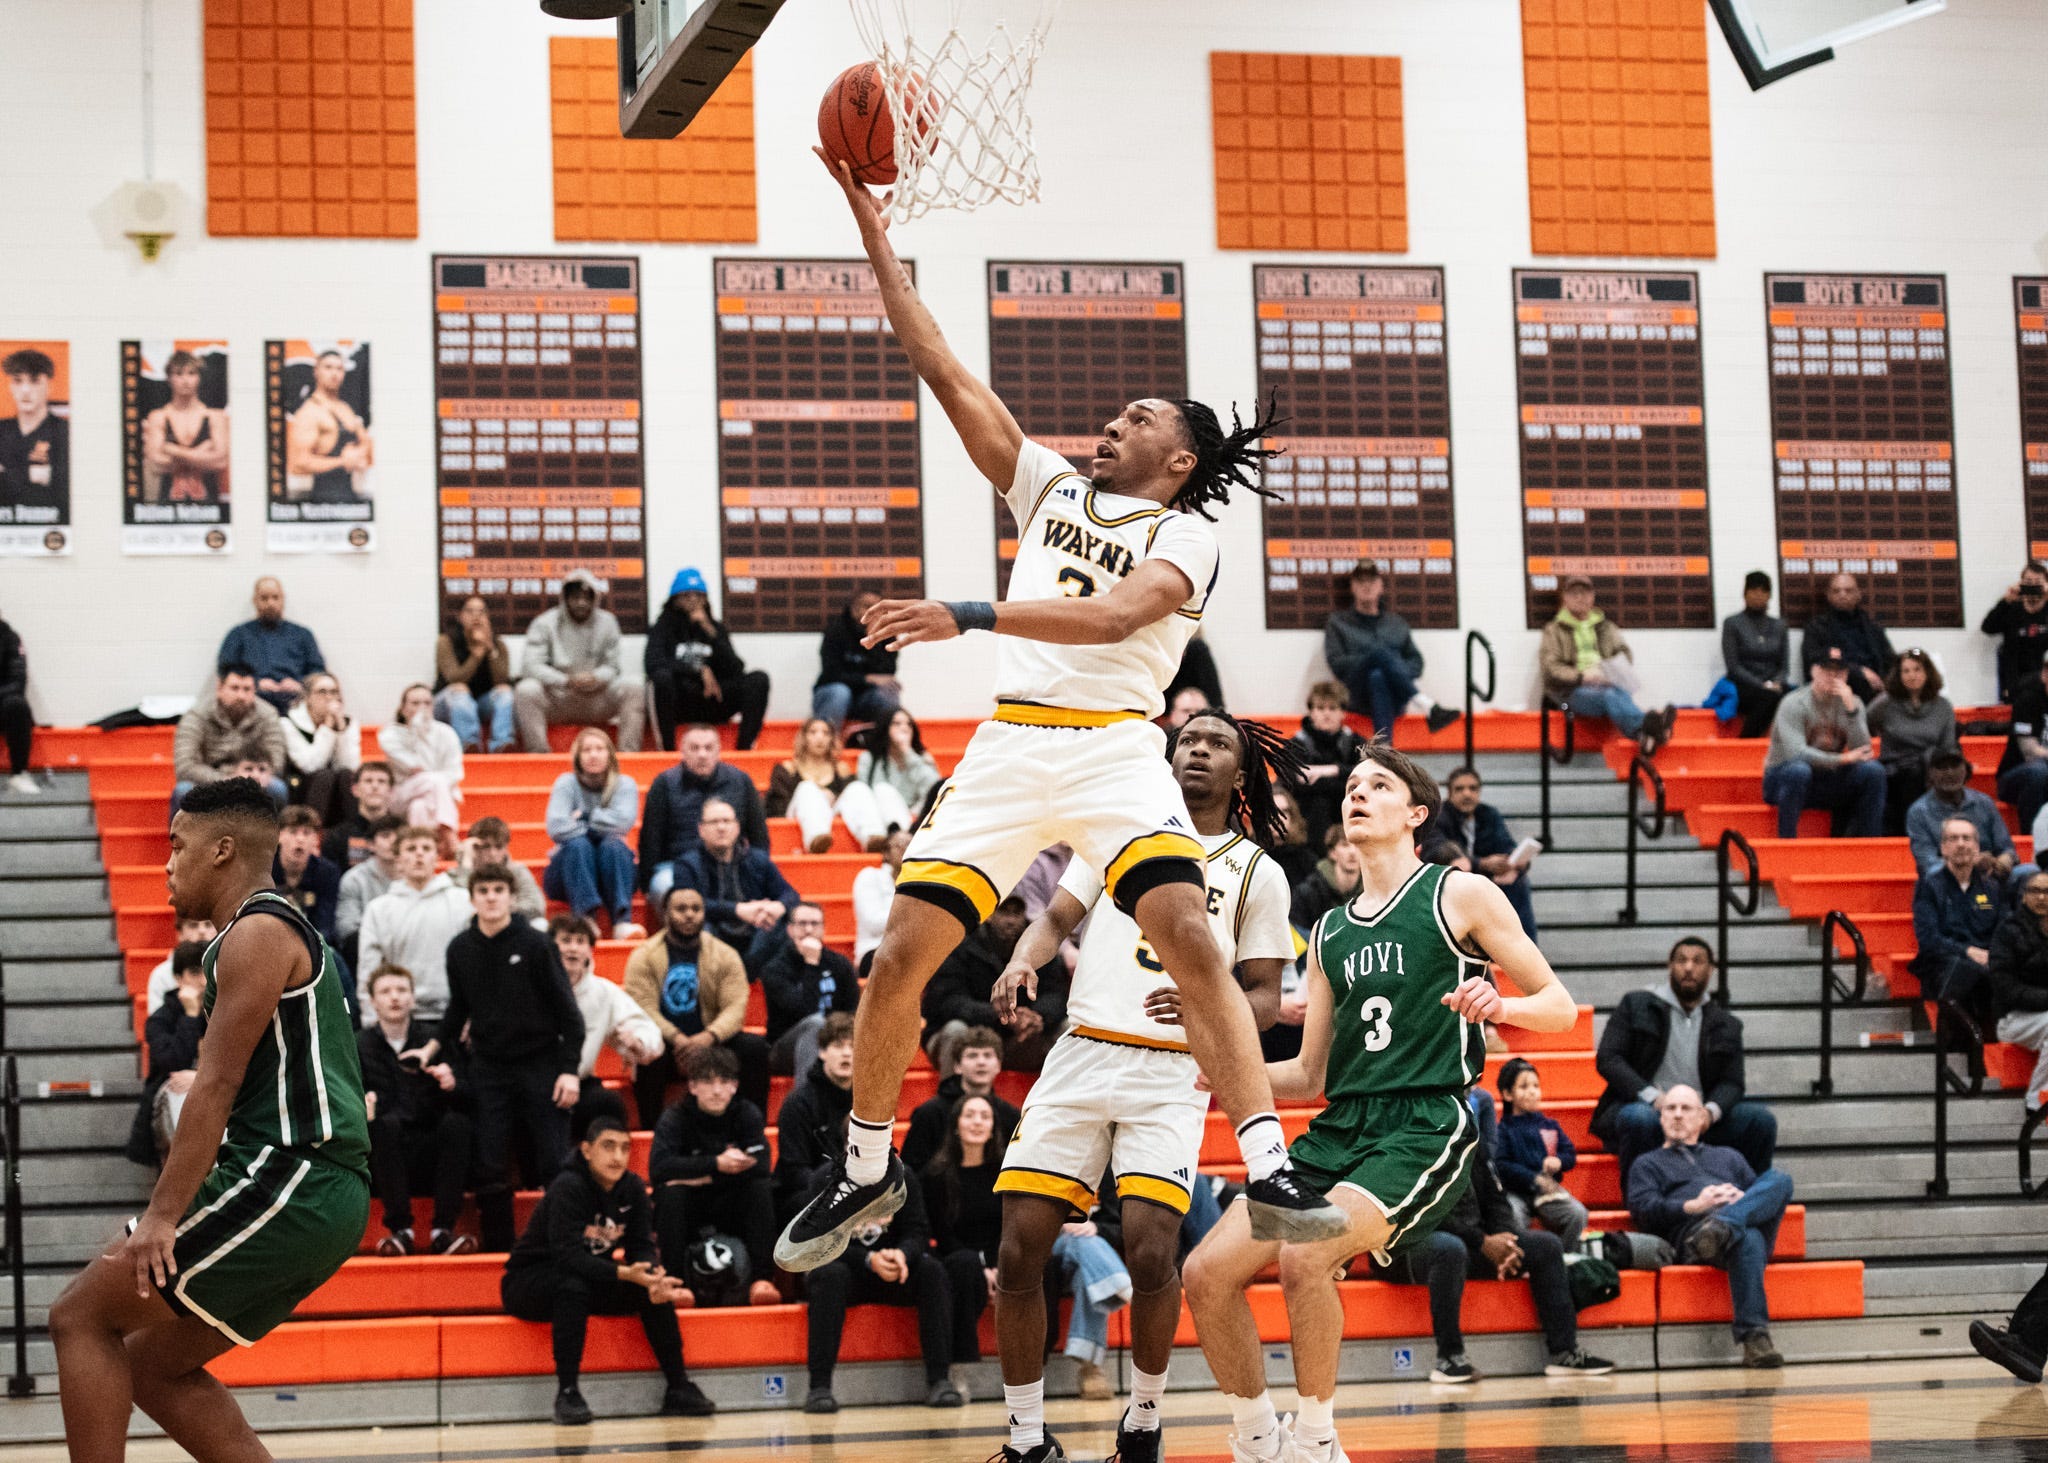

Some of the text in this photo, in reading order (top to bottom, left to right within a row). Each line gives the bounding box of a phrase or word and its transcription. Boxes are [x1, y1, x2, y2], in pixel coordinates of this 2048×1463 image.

[487, 263, 587, 289] BASEBALL
[1009, 269, 1162, 294] BOYS BOWLING
[1367, 275, 1436, 297] COUNTRY
[1561, 276, 1652, 302] FOOTBALL
[1804, 279, 1907, 306] BOYS GOLF
[1344, 942, 1404, 991] NOVI
[1361, 995, 1392, 1052] 3
